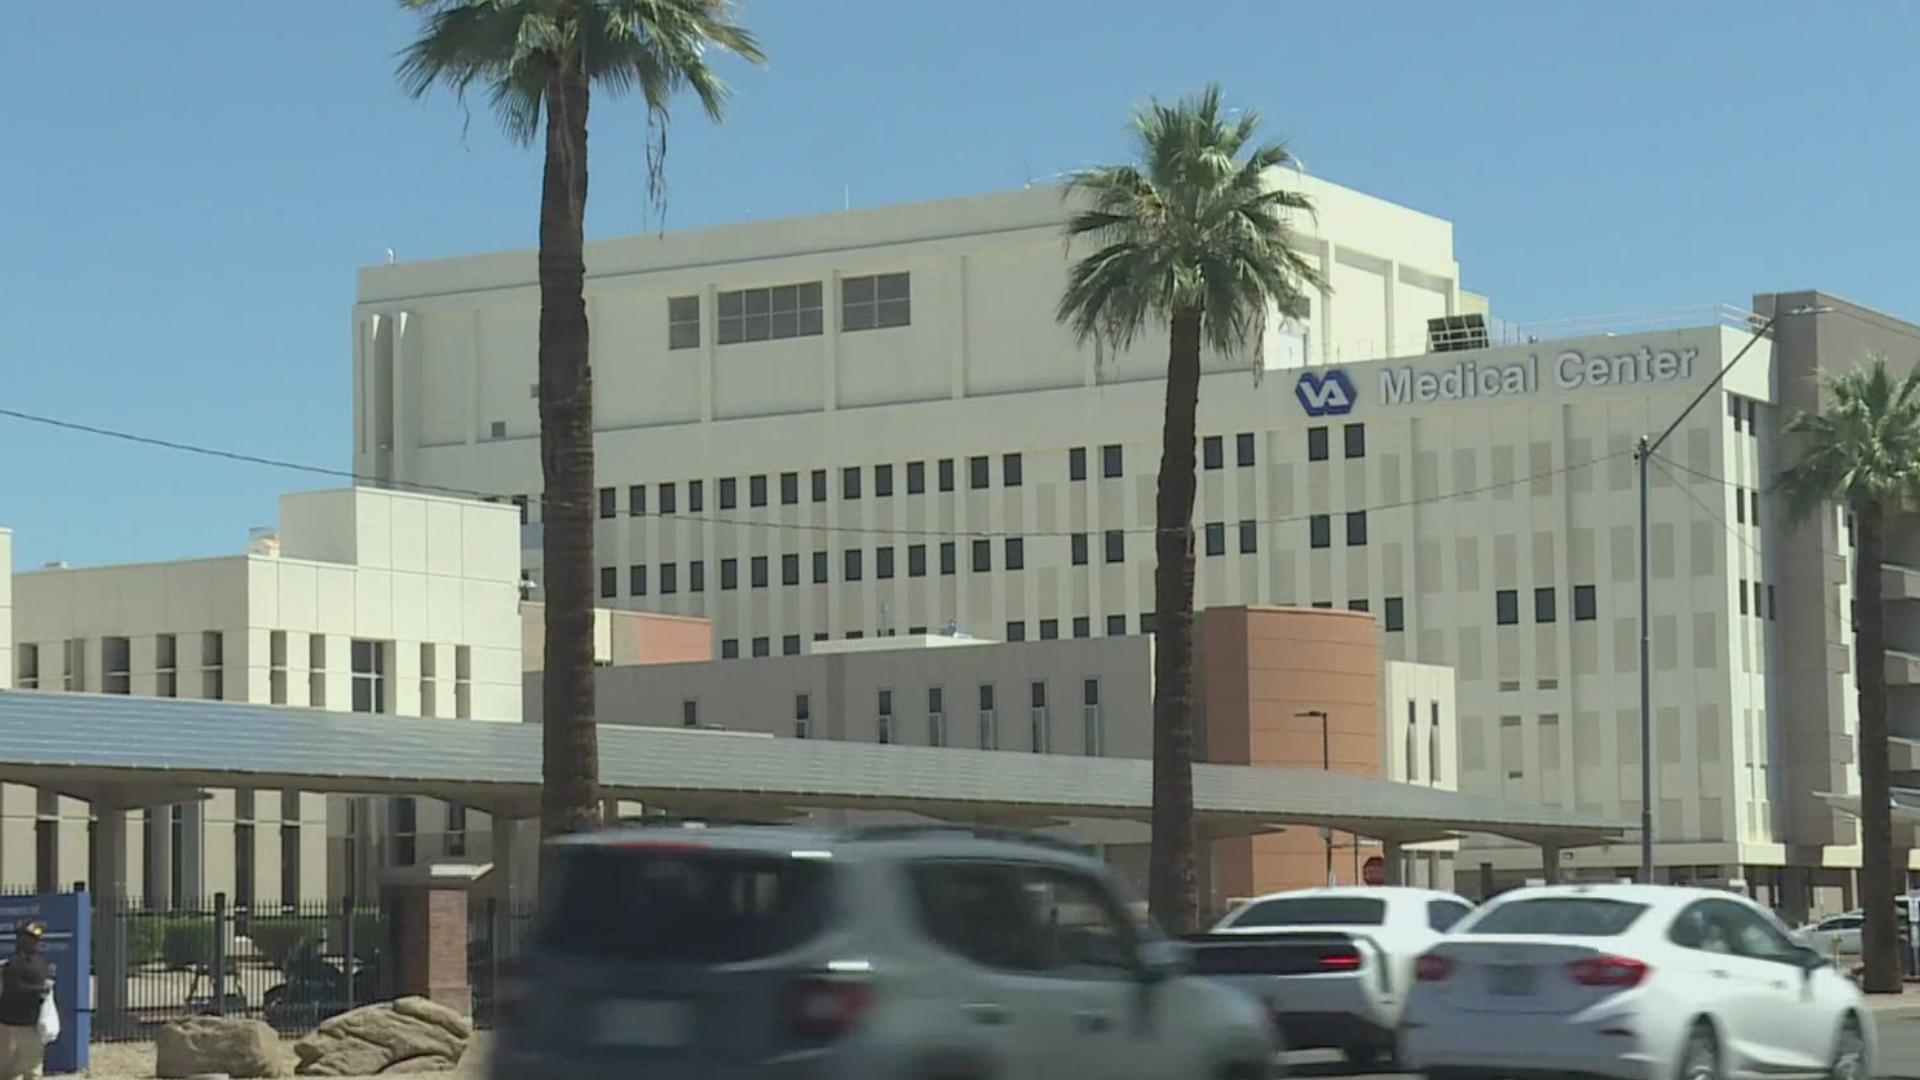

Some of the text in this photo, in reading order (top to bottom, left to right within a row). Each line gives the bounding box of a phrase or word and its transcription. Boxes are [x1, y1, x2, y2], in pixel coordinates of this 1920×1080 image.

[1299, 345, 1698, 409] VA Medical Center
